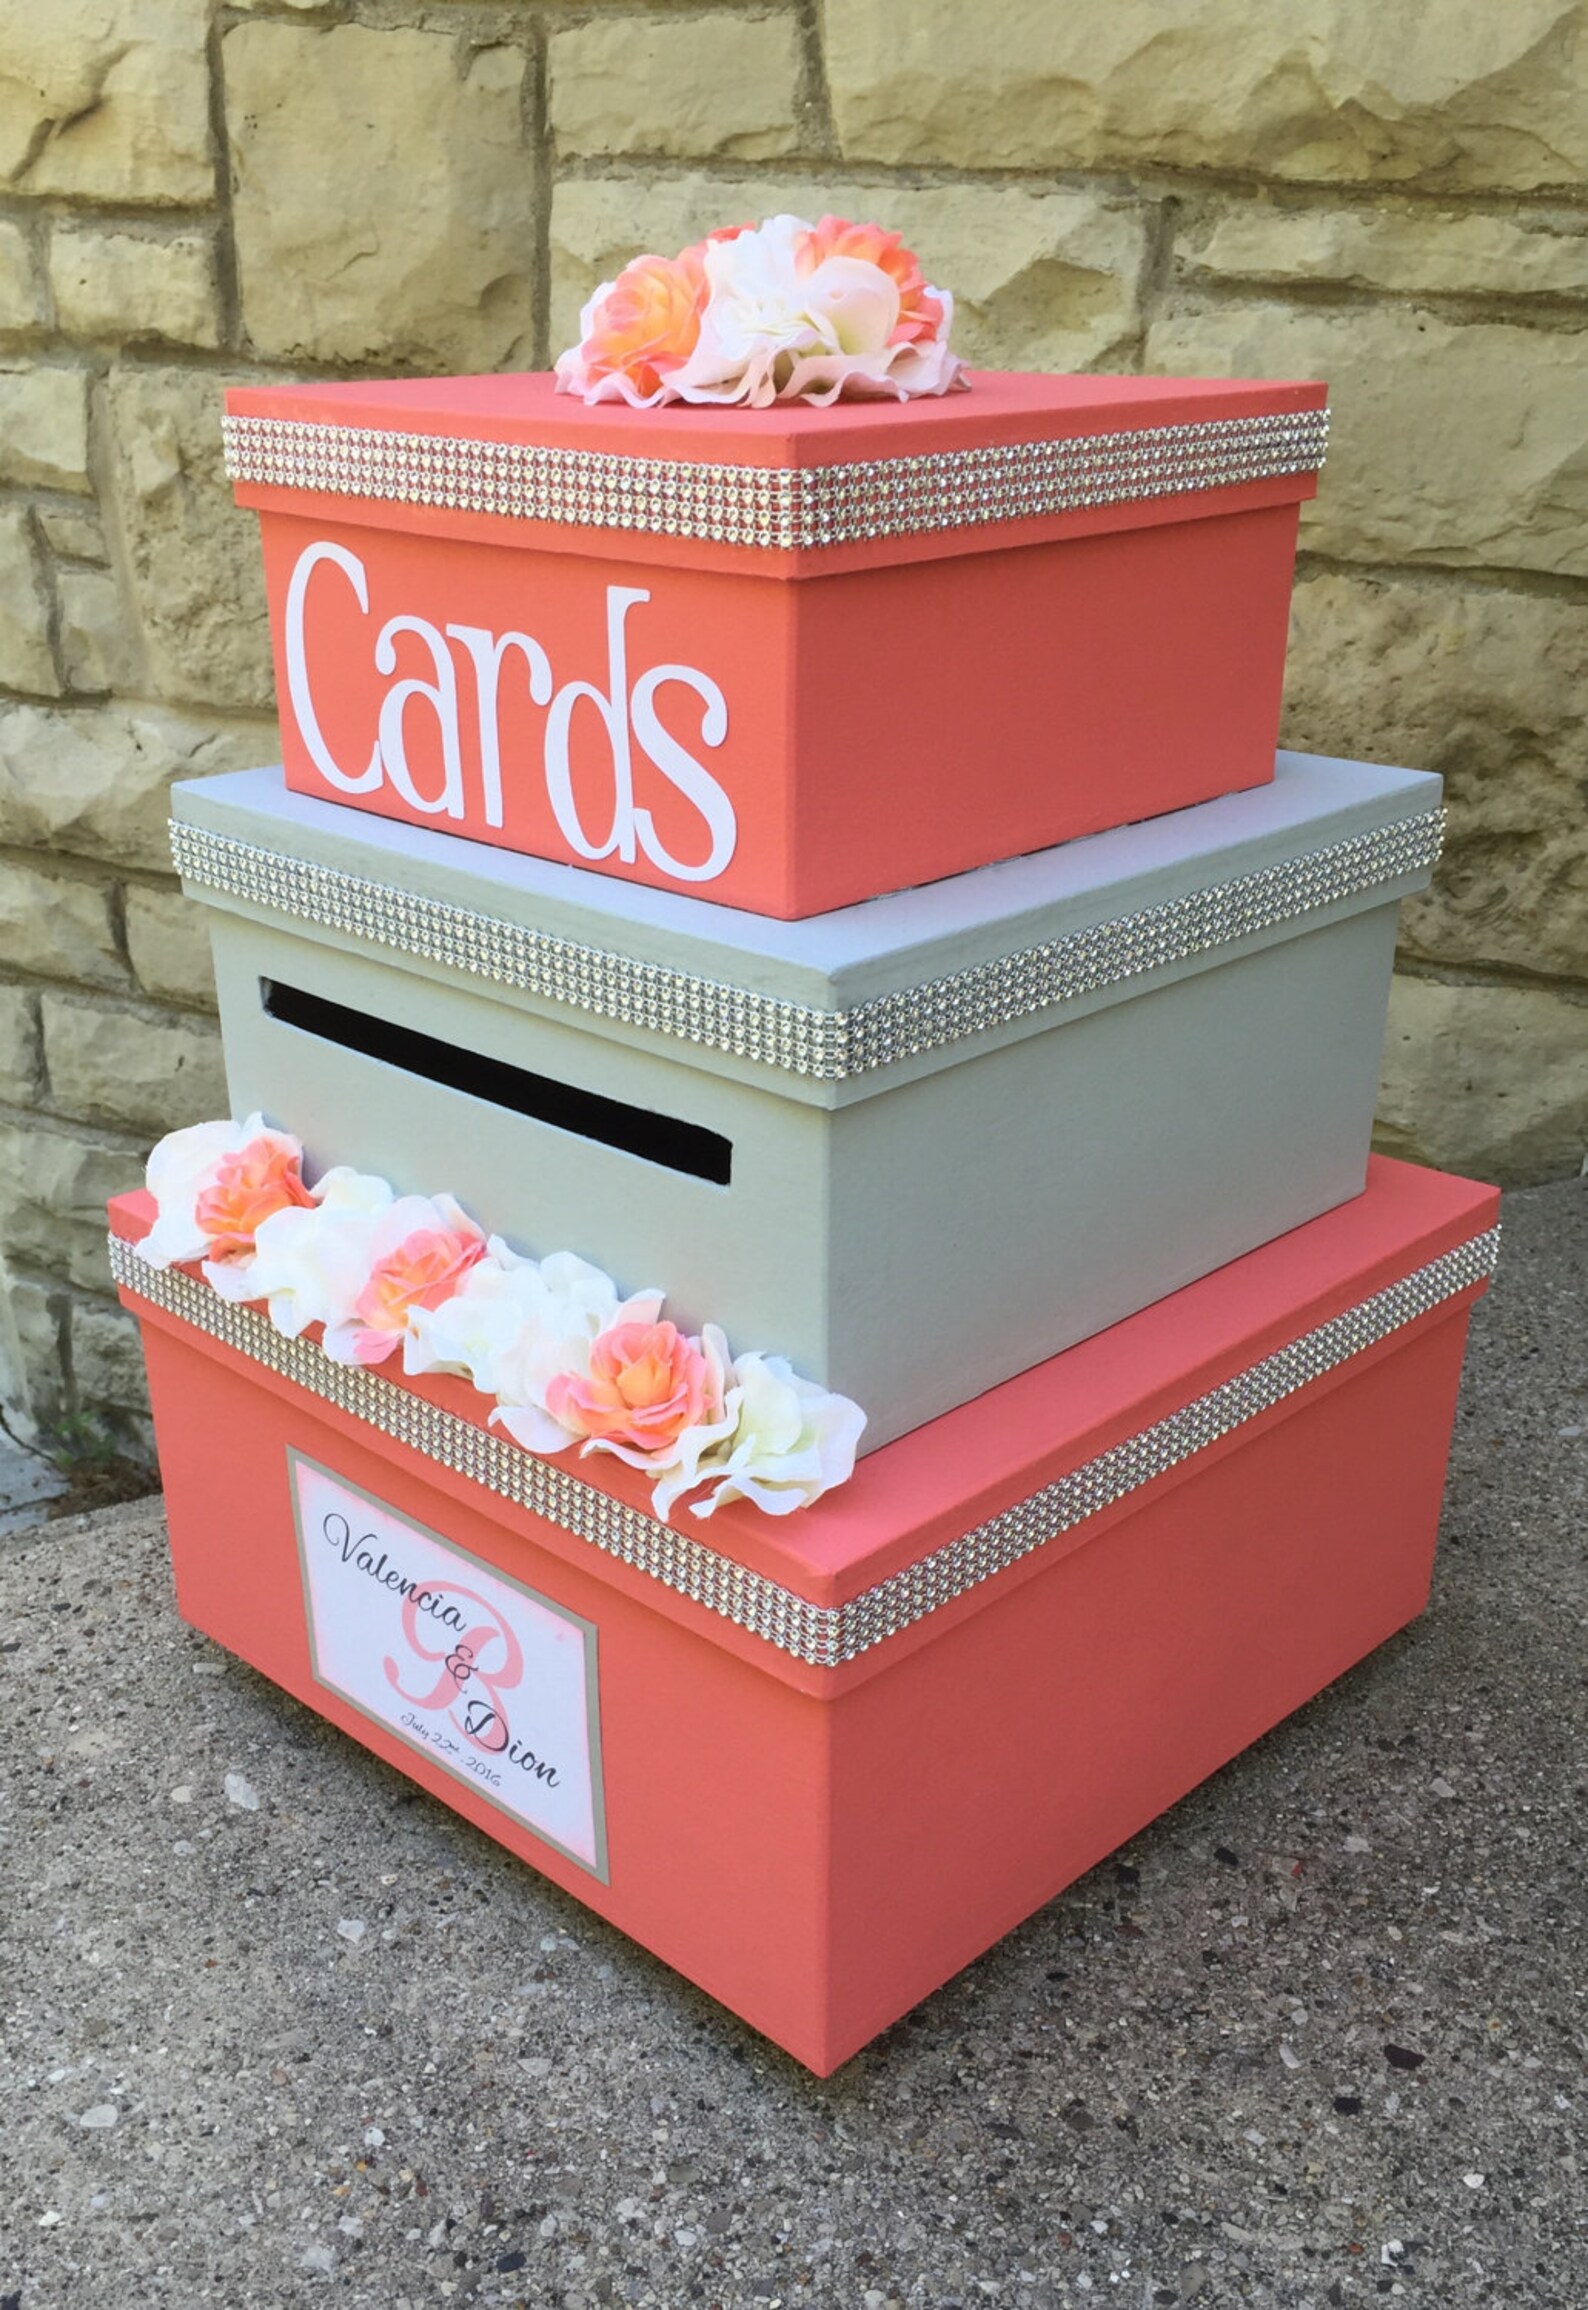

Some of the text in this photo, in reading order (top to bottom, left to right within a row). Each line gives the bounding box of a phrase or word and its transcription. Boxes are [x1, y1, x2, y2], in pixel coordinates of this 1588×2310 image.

[285, 541, 737, 881] Cards
[323, 1512, 466, 1632] Valencia
[444, 1644, 479, 1694] &
[400, 1712, 430, 1740] July
[464, 1699, 560, 1788] Dion
